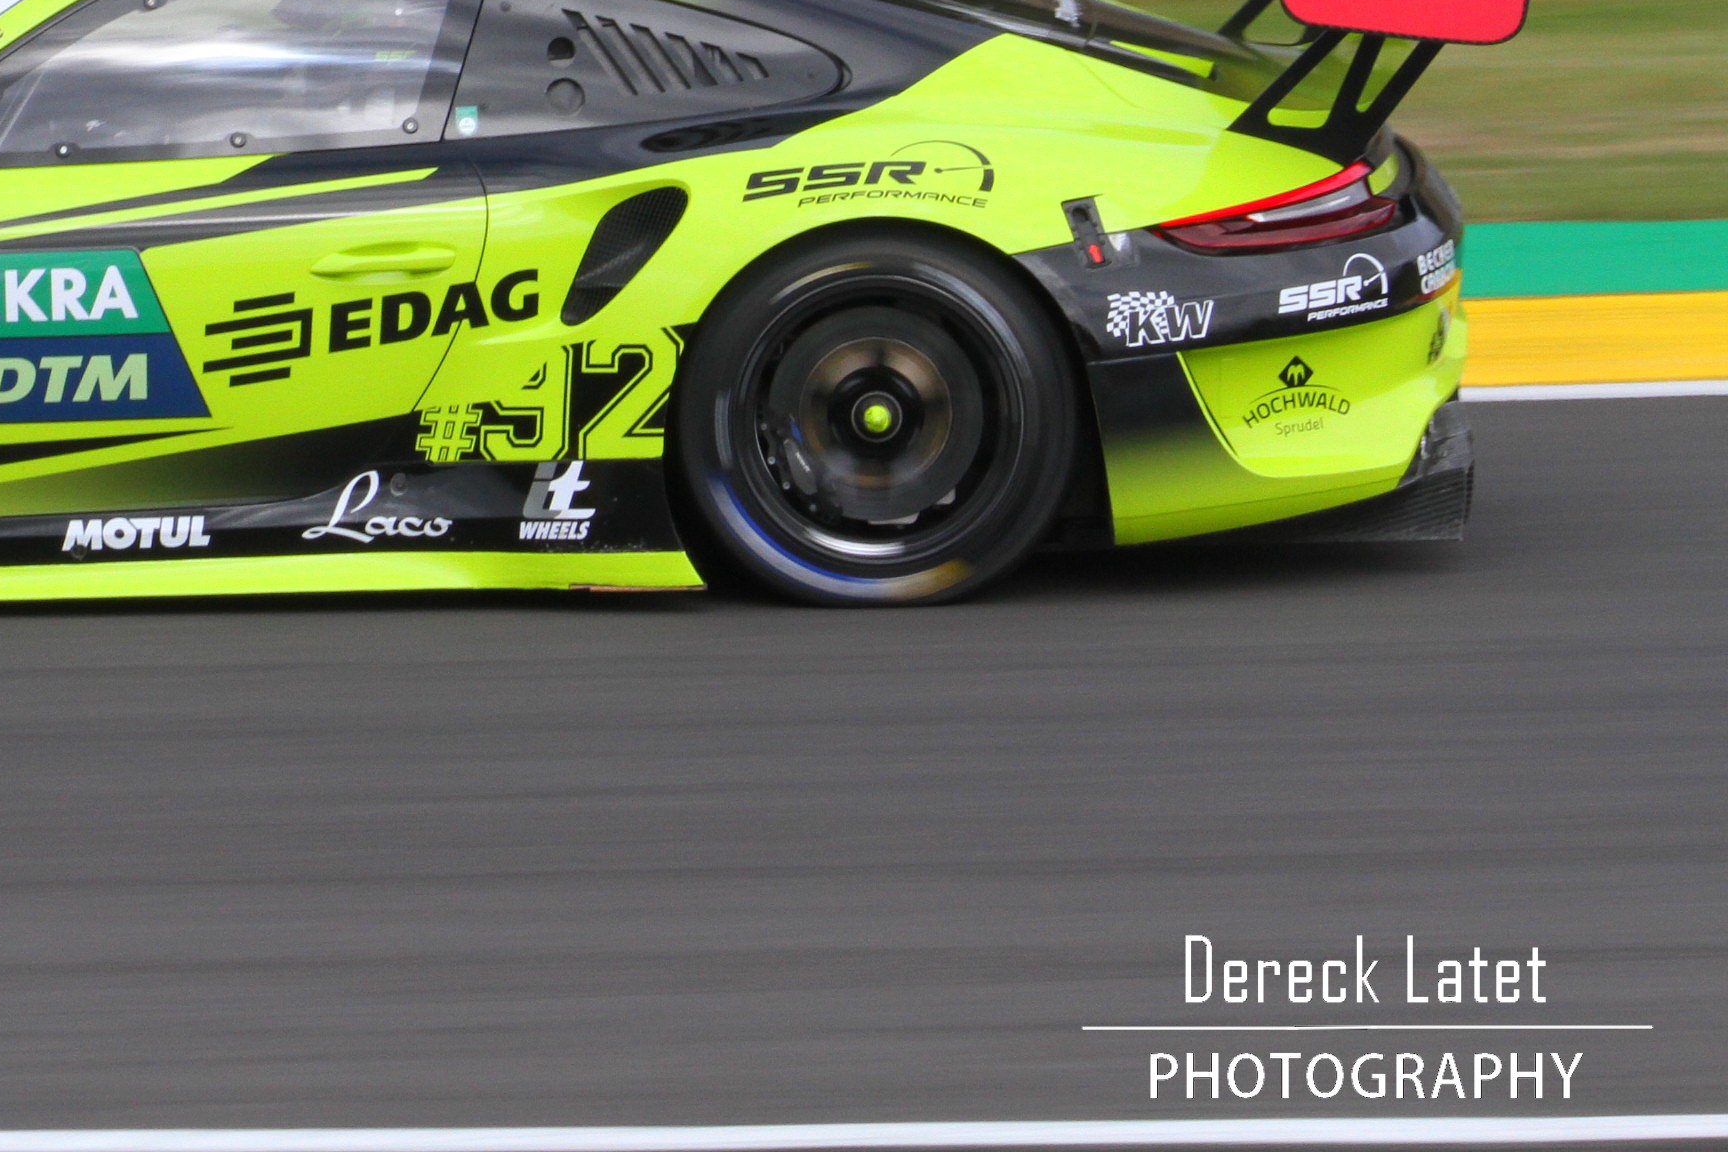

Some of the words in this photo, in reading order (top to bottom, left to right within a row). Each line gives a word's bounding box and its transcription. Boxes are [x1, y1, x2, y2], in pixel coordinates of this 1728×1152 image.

[742, 160, 927, 202] SSR
[798, 188, 988, 209] PERFORMANCE
[328, 269, 539, 353] EDAG
[1278, 275, 1363, 314] SSR
[1307, 297, 1389, 322] PERFORMANCE
[1126, 300, 1214, 348] KW
[1242, 390, 1351, 429] HOCHWALD
[1275, 418, 1325, 438] Sprudel
[302, 470, 453, 543] Laco
[62, 515, 211, 552] MOTUL
[518, 521, 591, 540] WHEELS
